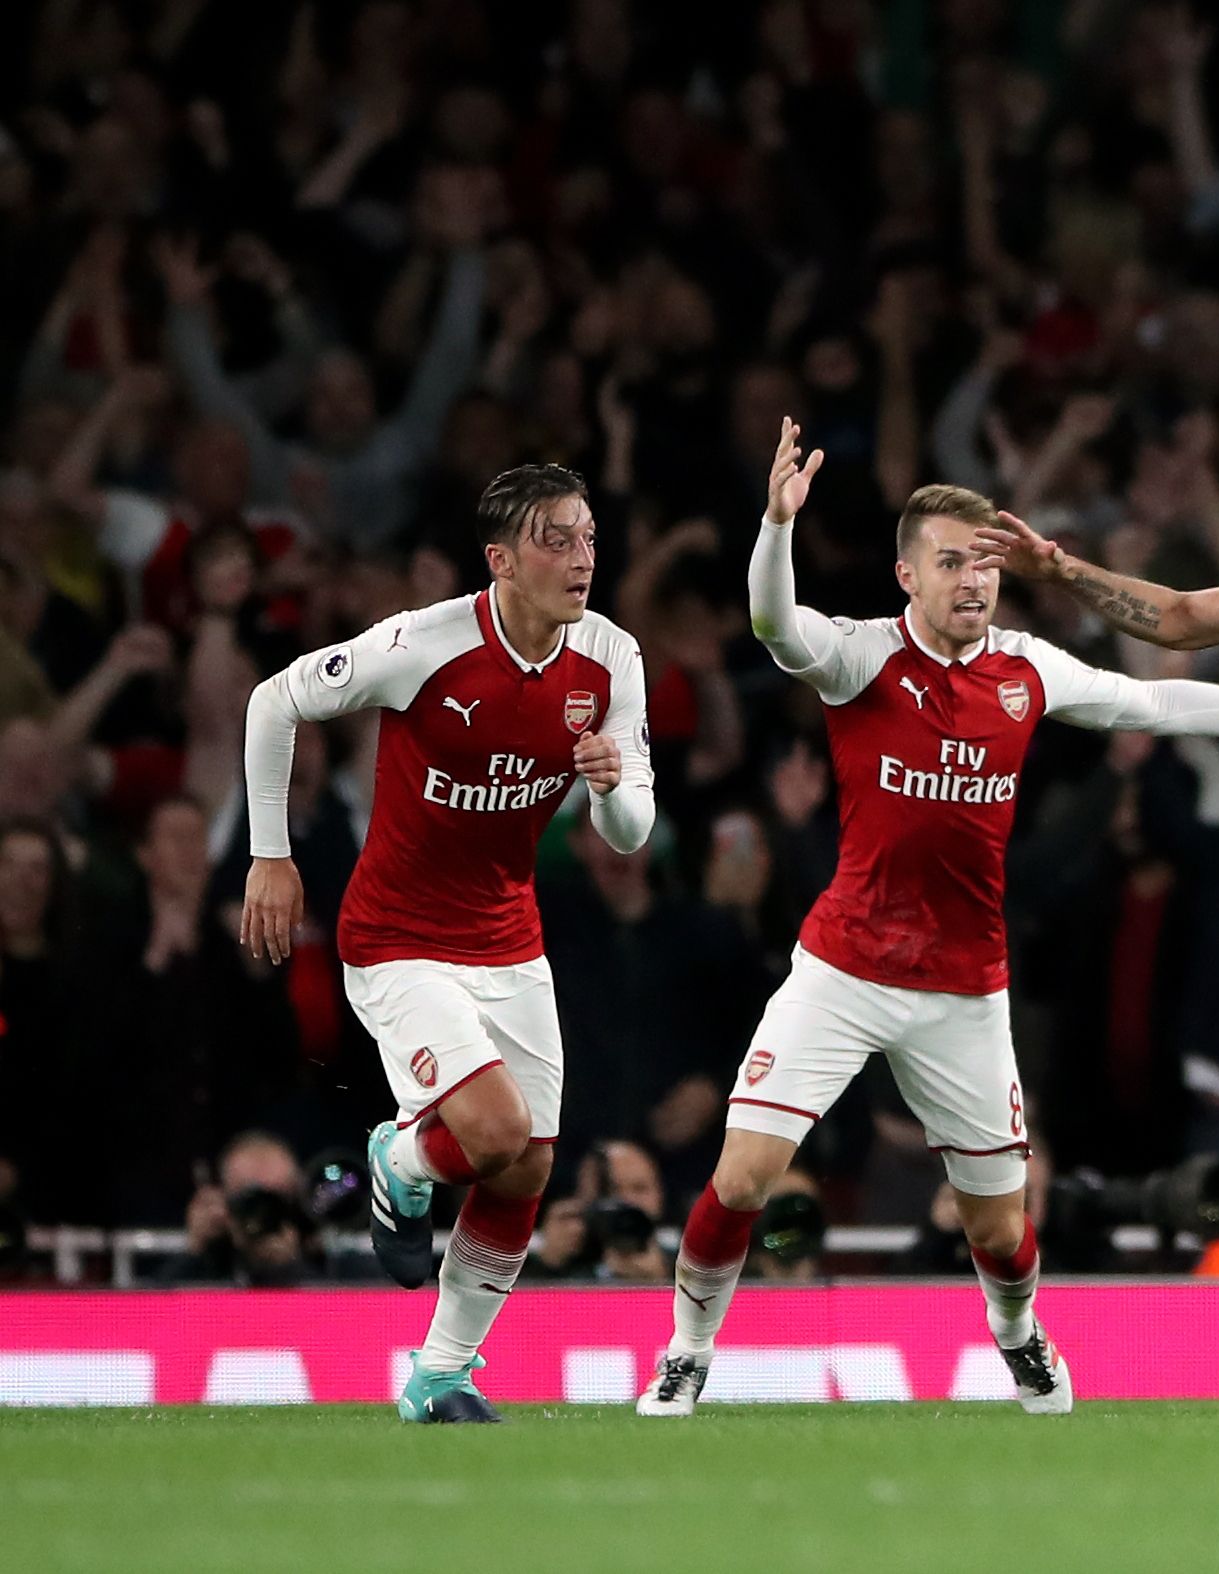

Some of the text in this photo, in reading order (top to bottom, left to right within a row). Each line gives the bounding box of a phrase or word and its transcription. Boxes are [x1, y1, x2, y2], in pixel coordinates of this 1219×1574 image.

[488, 753, 536, 780] Fly
[940, 739, 986, 771] Fly
[423, 766, 569, 812] Emirates
[879, 754, 1017, 804] Emirates
[1009, 1081, 1022, 1137] 8
